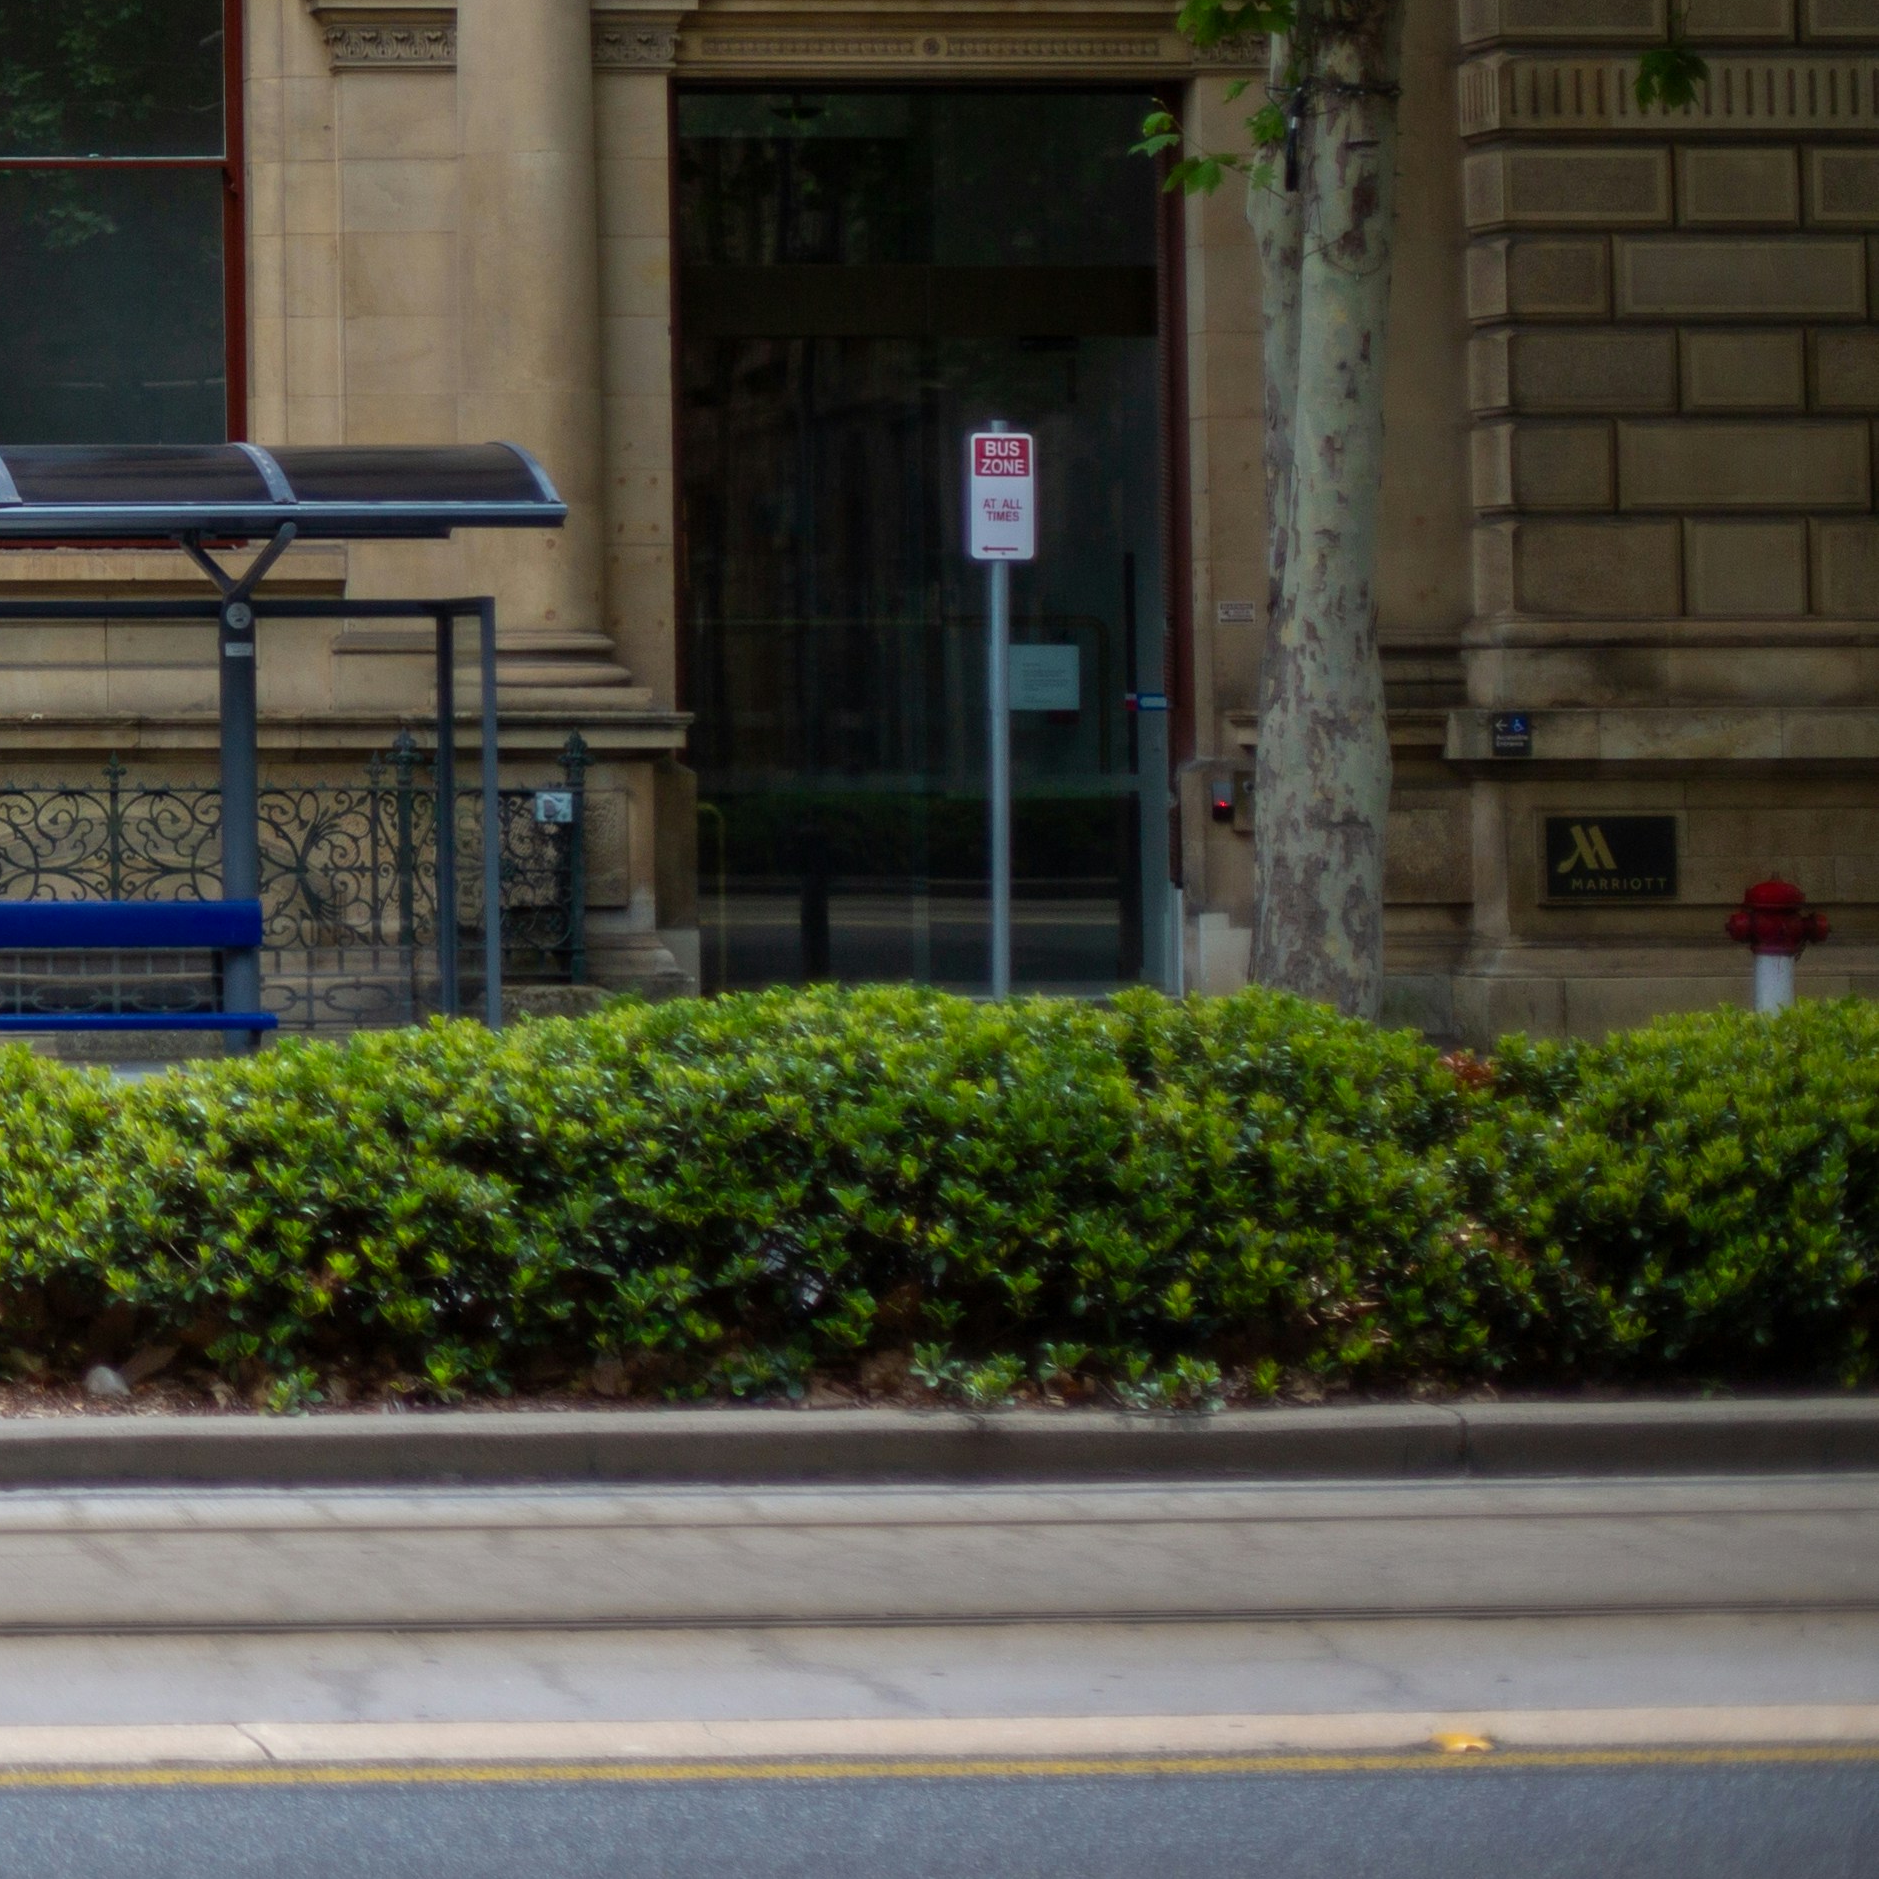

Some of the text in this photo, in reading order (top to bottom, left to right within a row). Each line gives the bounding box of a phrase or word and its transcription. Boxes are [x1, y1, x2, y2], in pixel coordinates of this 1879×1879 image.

[985, 440, 1020, 457] BUS
[980, 458, 1025, 474] ZONE
[983, 498, 1023, 510] AT ALL
[986, 510, 1020, 522] TIMES
[1570, 877, 1668, 891] MARRIOTT
